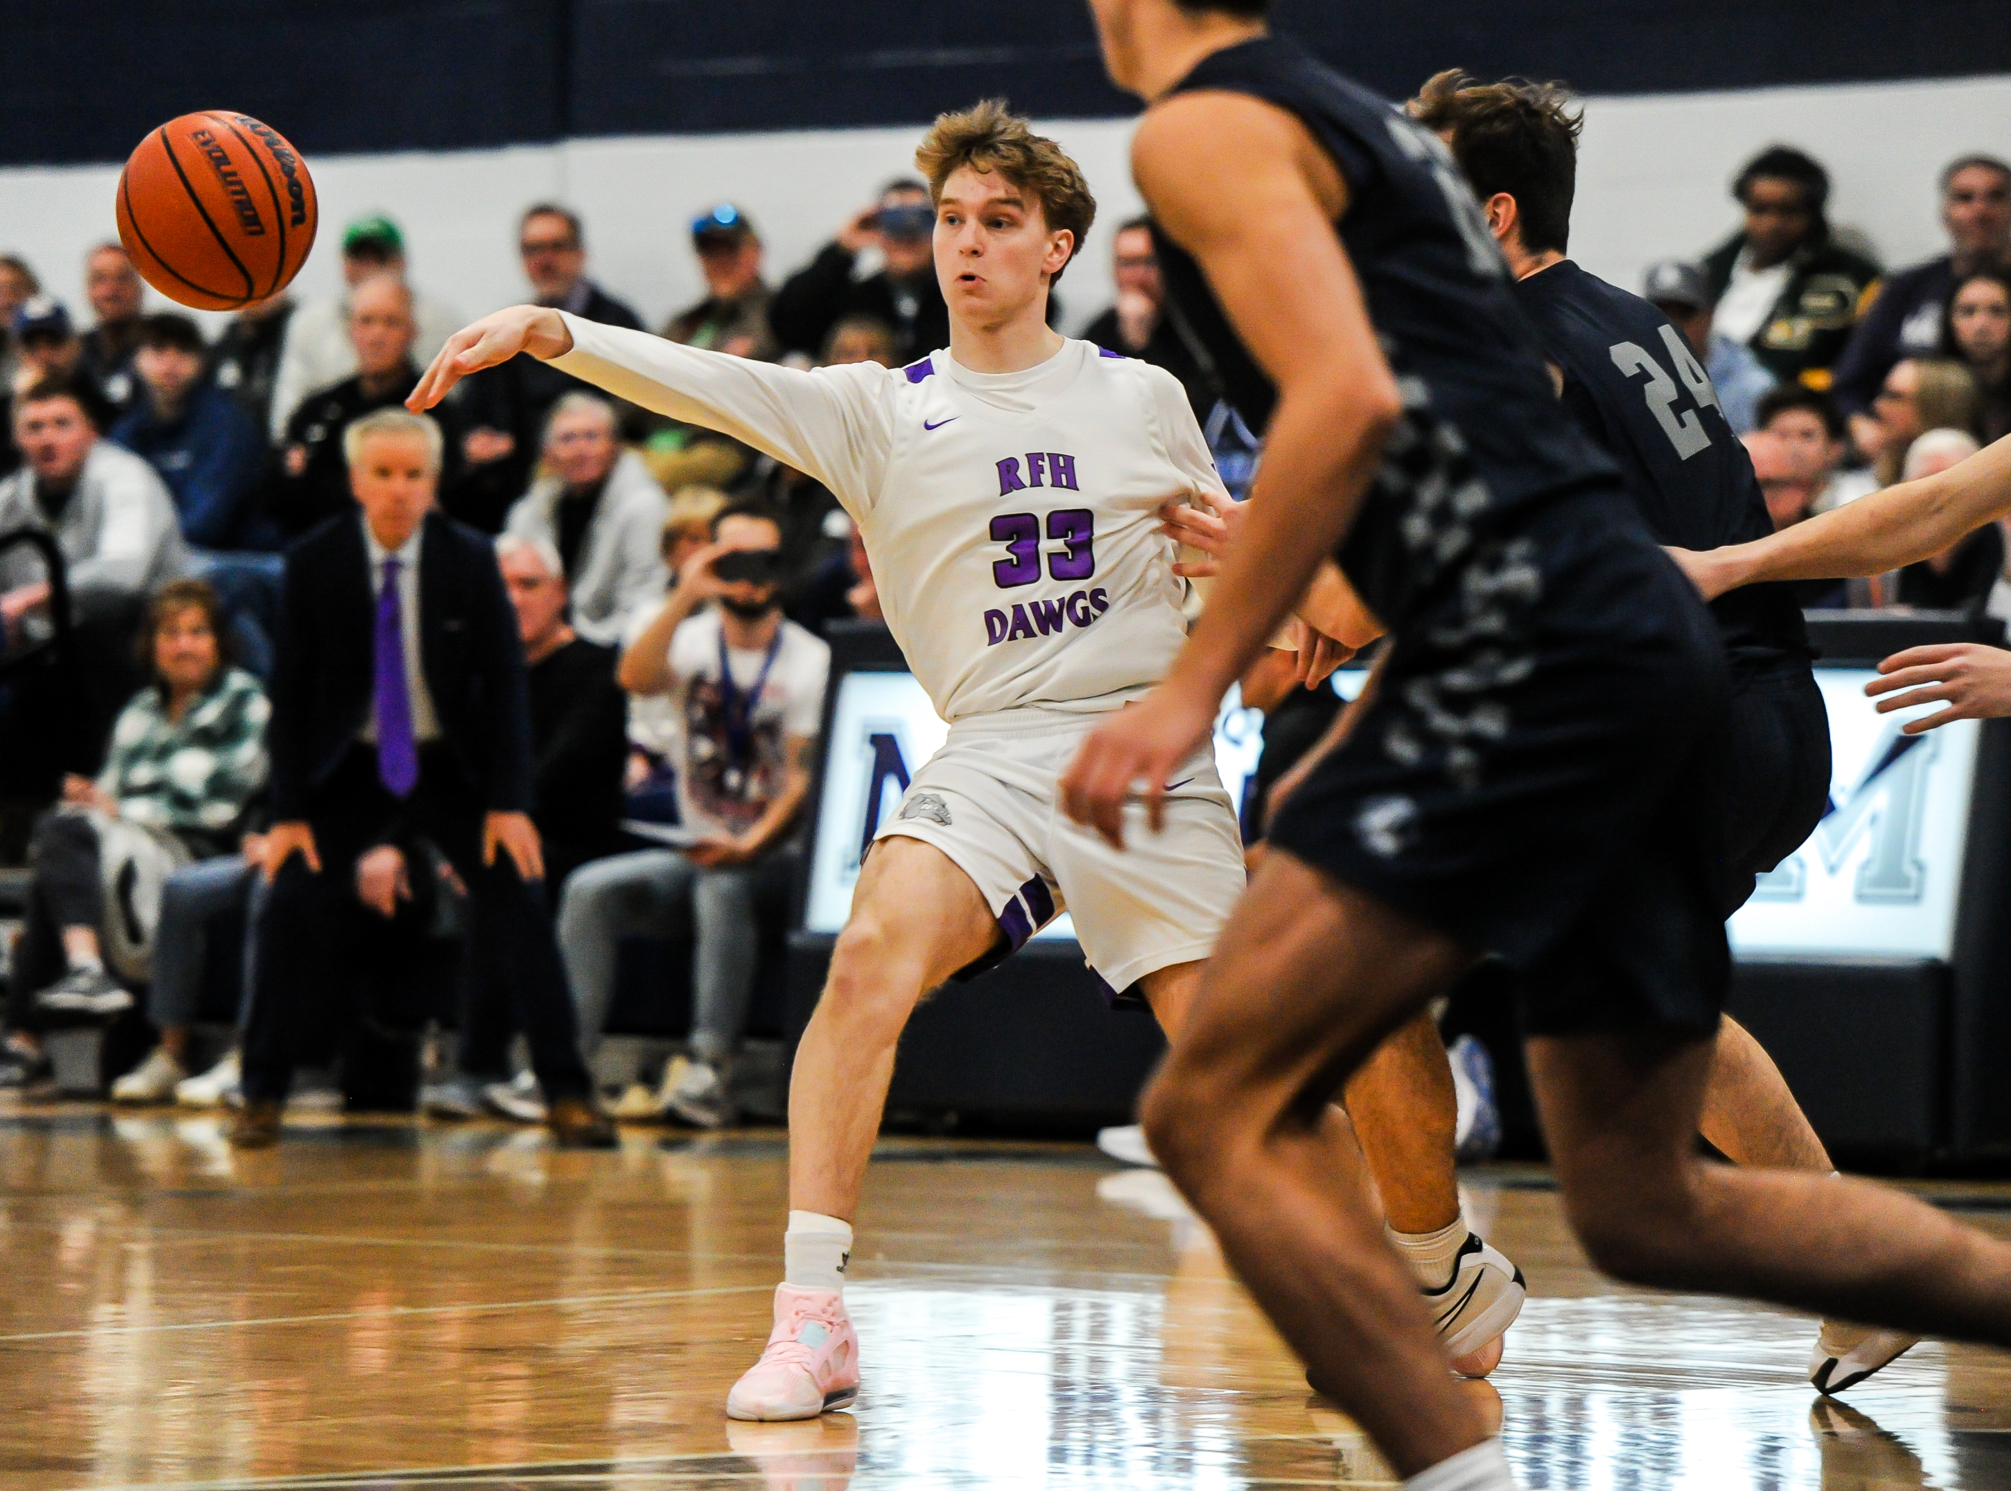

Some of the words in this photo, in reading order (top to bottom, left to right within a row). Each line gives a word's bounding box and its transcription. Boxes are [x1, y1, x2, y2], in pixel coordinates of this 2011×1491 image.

[193, 130, 265, 236] EVOLUTION
[1609, 324, 1725, 461] 24
[996, 453, 1079, 496] RFH
[989, 508, 1095, 588] 33
[984, 588, 1109, 646] DAWGS
